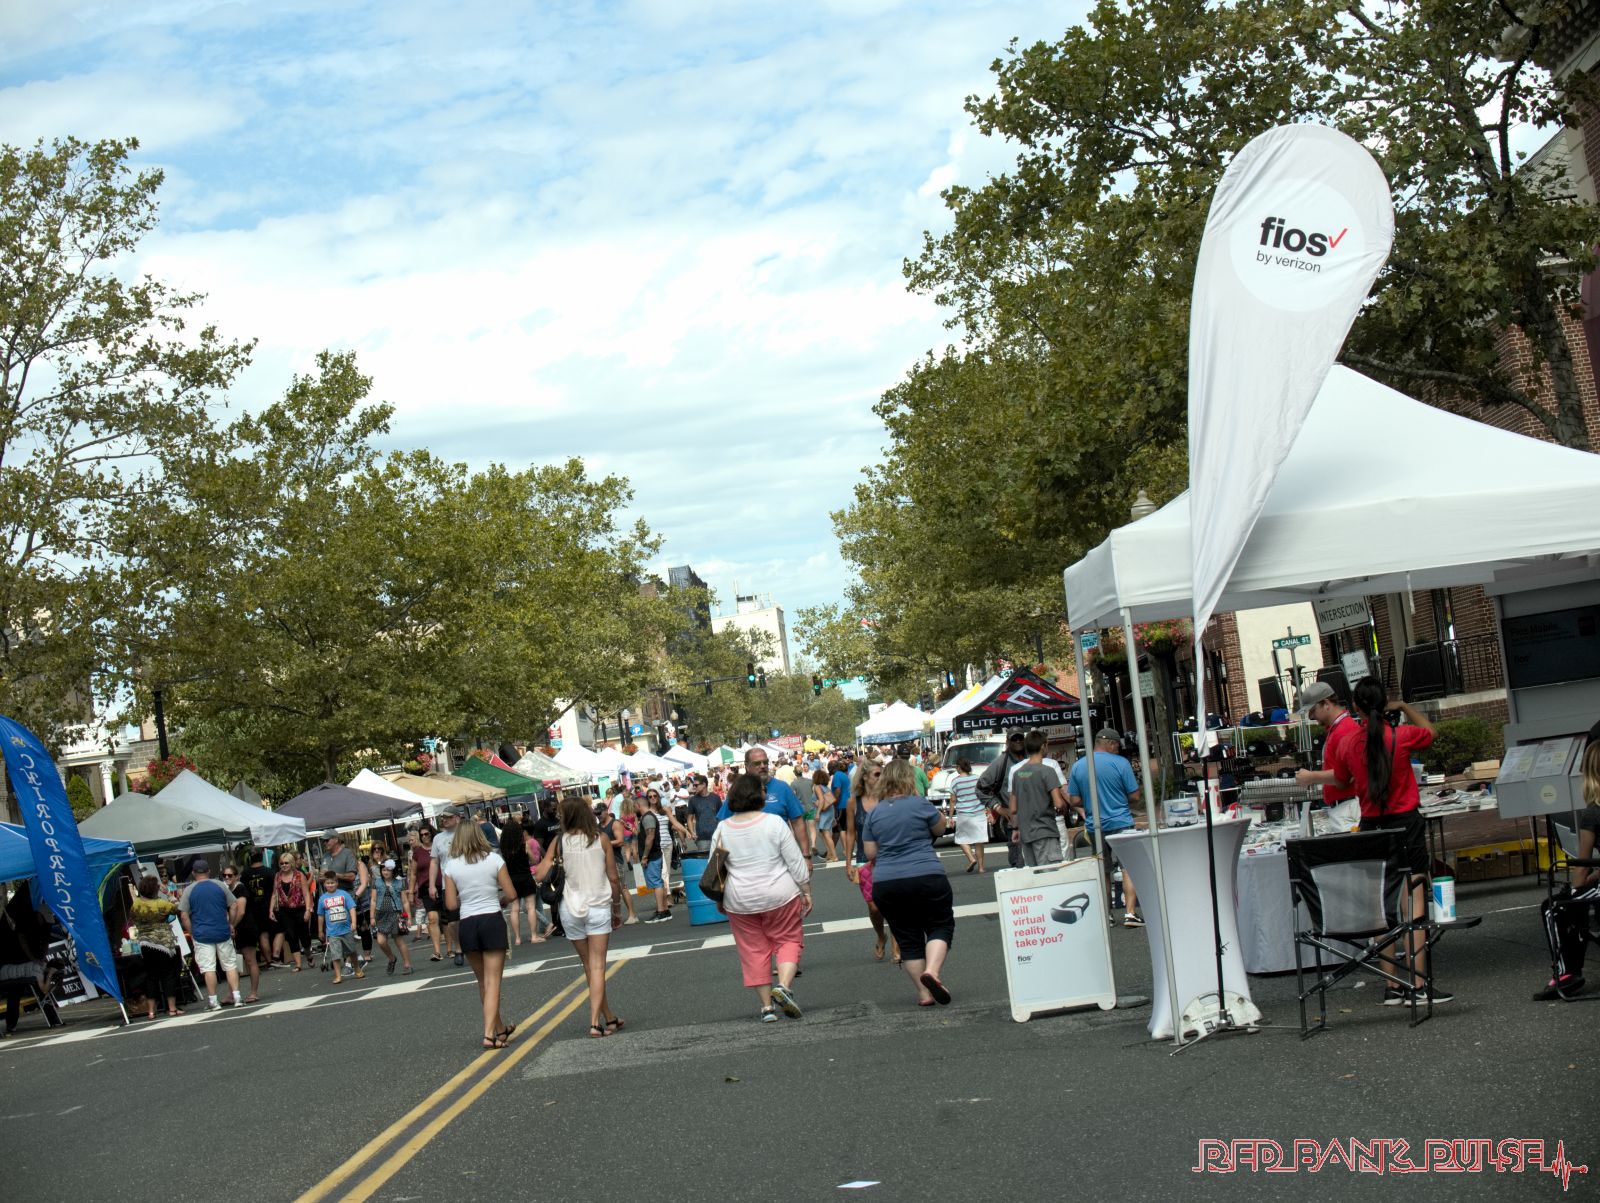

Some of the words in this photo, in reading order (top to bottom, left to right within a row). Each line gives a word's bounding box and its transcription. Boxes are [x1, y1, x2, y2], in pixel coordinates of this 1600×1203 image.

[1259, 216, 1328, 257] fios
[1256, 250, 1272, 265] by
[1275, 256, 1321, 273] verizon
[1318, 602, 1365, 624] INTERSECTION
[1280, 638, 1300, 647] CANAL
[1301, 636, 1310, 644] ST
[963, 718, 997, 729] ELITE
[1000, 711, 1059, 726] ATHLETIC
[1062, 708, 1098, 721] GER
[1010, 894, 1044, 905] Where
[1011, 905, 1029, 916] will
[1012, 914, 1045, 926] virtual
[1014, 926, 1046, 938] reality
[1015, 938, 1038, 948] take
[1039, 933, 1064, 947] you?
